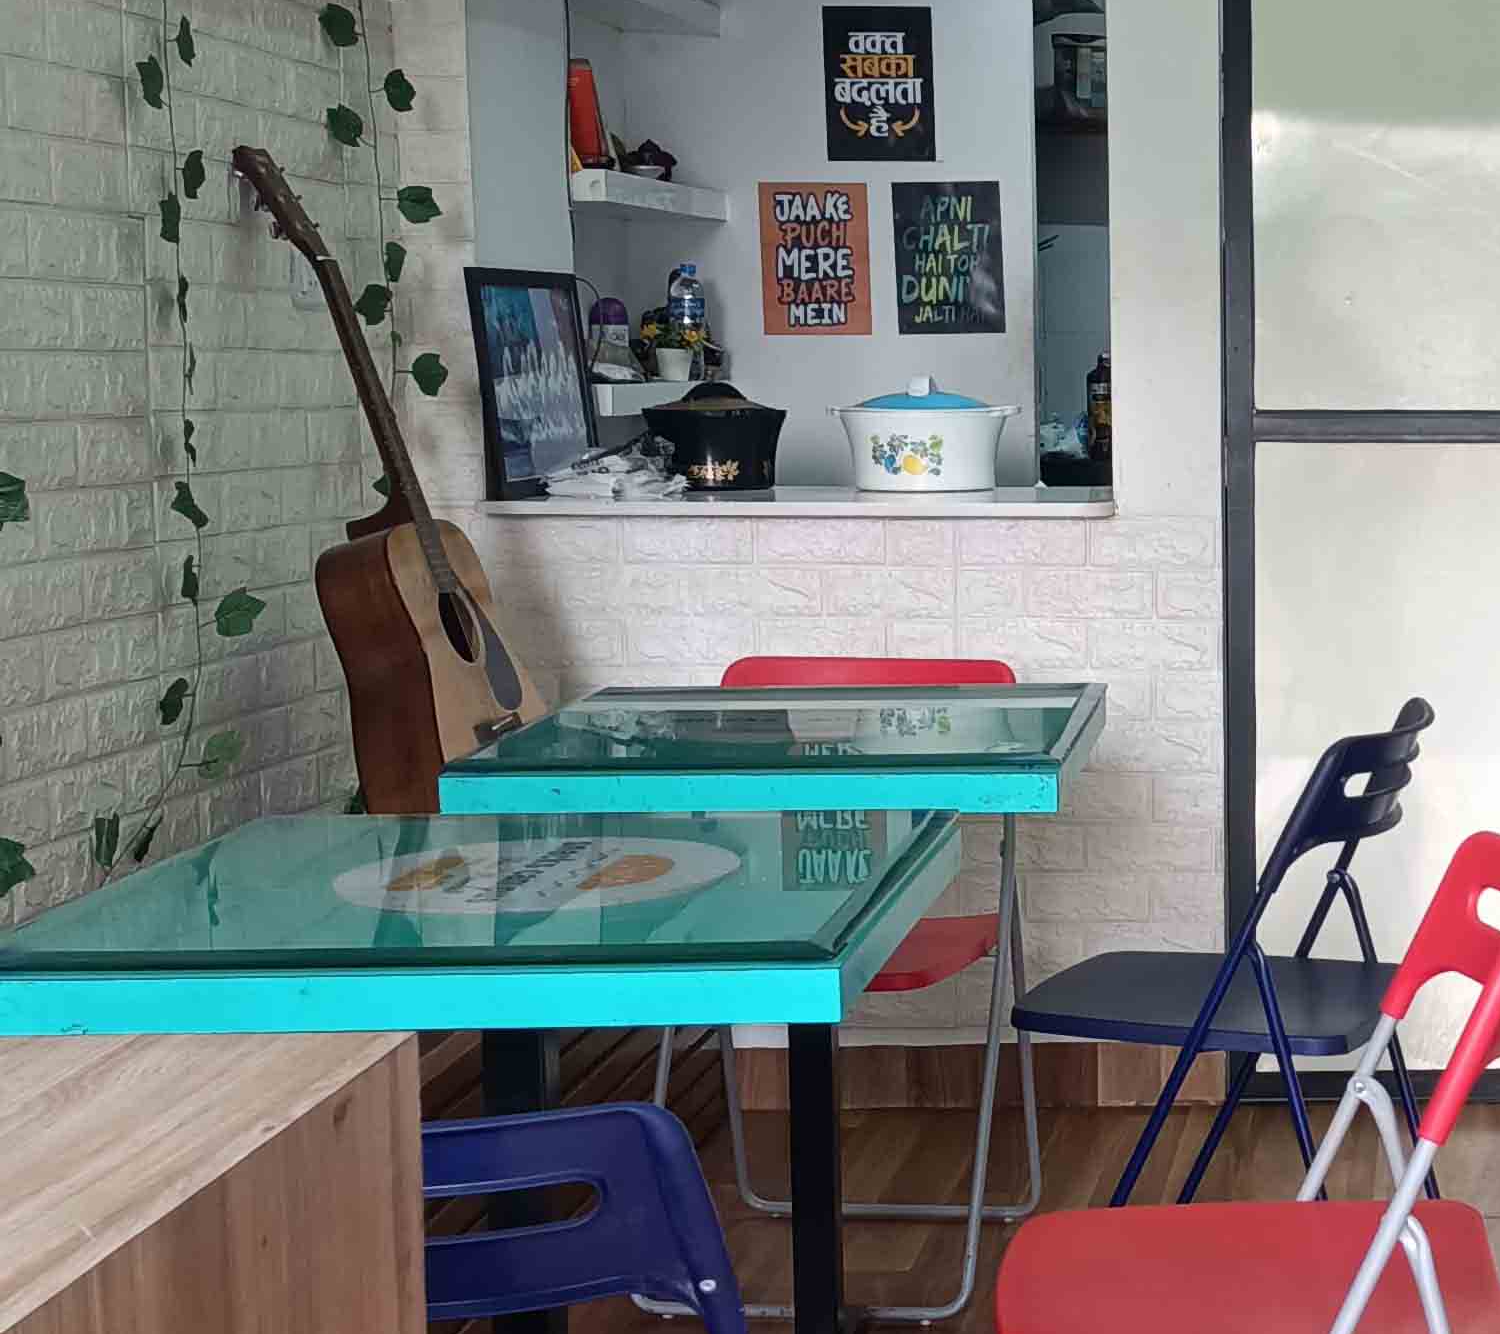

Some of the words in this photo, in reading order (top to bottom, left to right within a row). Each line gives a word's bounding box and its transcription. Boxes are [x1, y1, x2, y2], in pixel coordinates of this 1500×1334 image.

[848, 31, 906, 55] वक्त
[839, 53, 916, 78] सबका
[833, 77, 924, 106] बदलता
[869, 105, 891, 137] है
[920, 195, 973, 223] APNI
[780, 221, 849, 248] PUCH
[902, 222, 991, 254] CHALTI
[777, 246, 854, 281] MERE
[914, 252, 943, 276] HAI
[779, 278, 853, 304] BAARE
[789, 303, 847, 327] MEIN
[913, 304, 957, 324] JALTI
